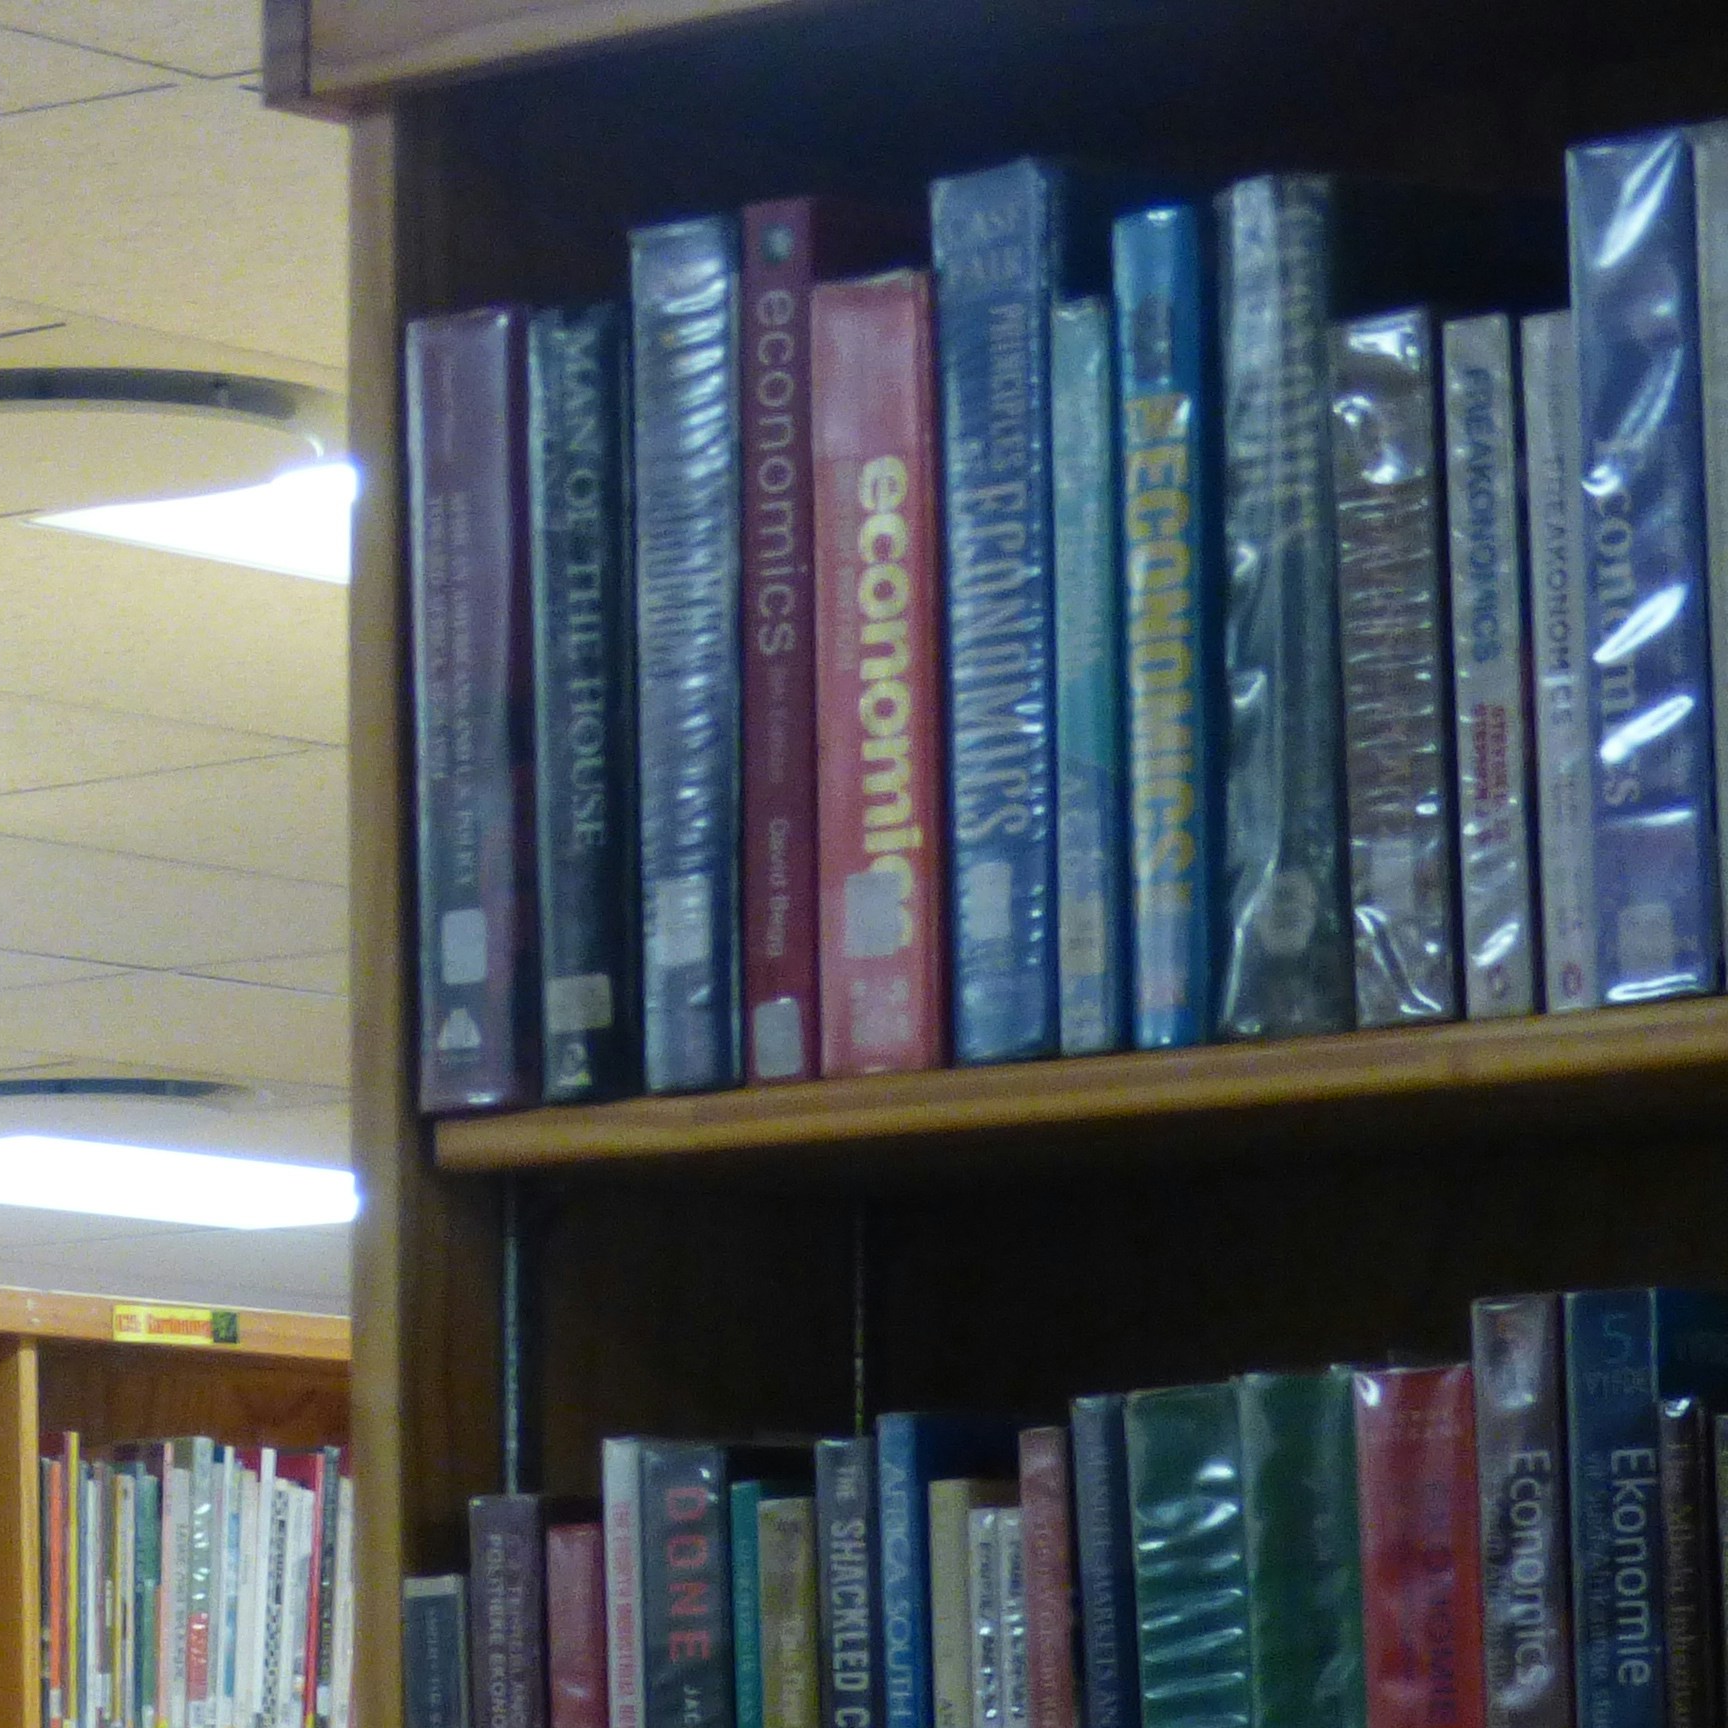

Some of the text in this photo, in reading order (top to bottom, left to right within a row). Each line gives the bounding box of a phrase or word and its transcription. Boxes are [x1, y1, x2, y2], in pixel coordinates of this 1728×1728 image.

[758, 289, 809, 656] economics
[954, 481, 1032, 843] ECONOMICS
[665, 1486, 711, 1663] DONE
[829, 1518, 869, 1693] SHACKLED
[883, 1462, 911, 1584] AFRICA
[1509, 1450, 1556, 1688] Economics
[1611, 1447, 1661, 1687] Ekonomie
[884, 1597, 914, 1717] SOUTH
